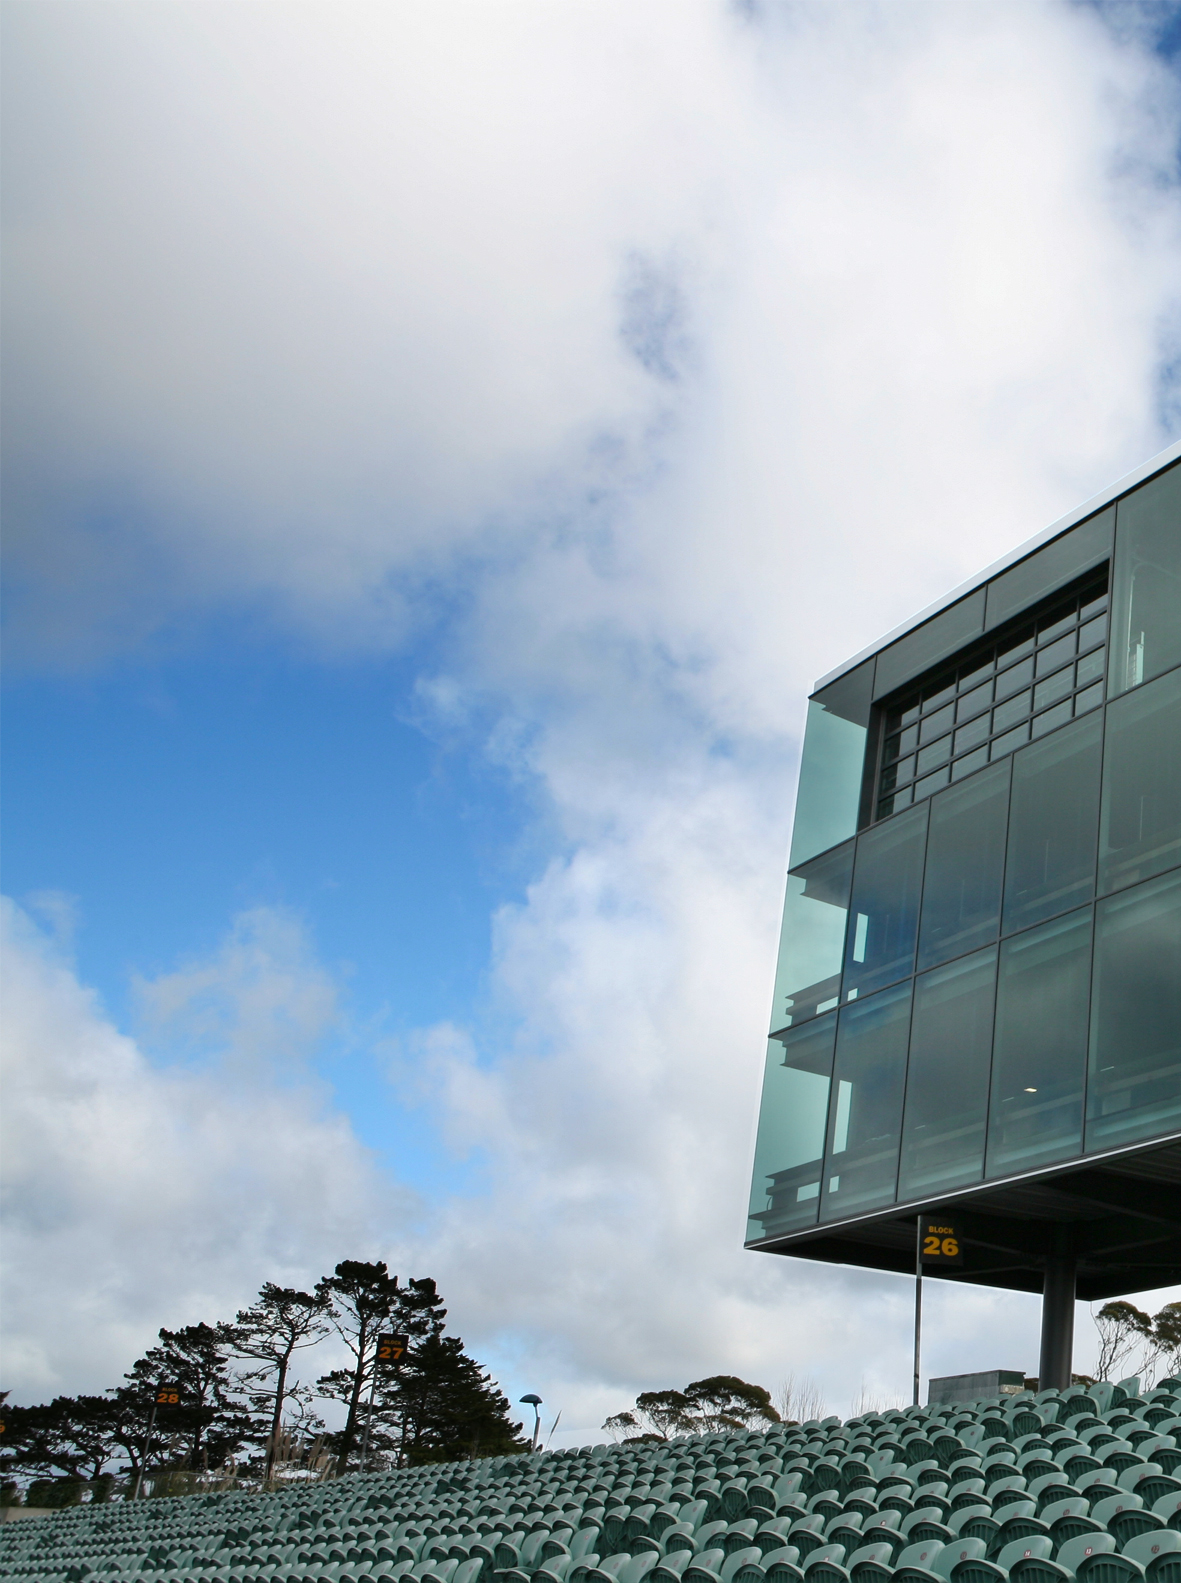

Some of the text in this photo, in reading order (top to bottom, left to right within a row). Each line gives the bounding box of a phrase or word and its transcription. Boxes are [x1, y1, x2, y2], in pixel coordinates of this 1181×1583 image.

[928, 1226, 954, 1234] BLOCK
[923, 1236, 959, 1256] 26
[379, 1346, 404, 1359] 27
[157, 1392, 179, 1404] 28
